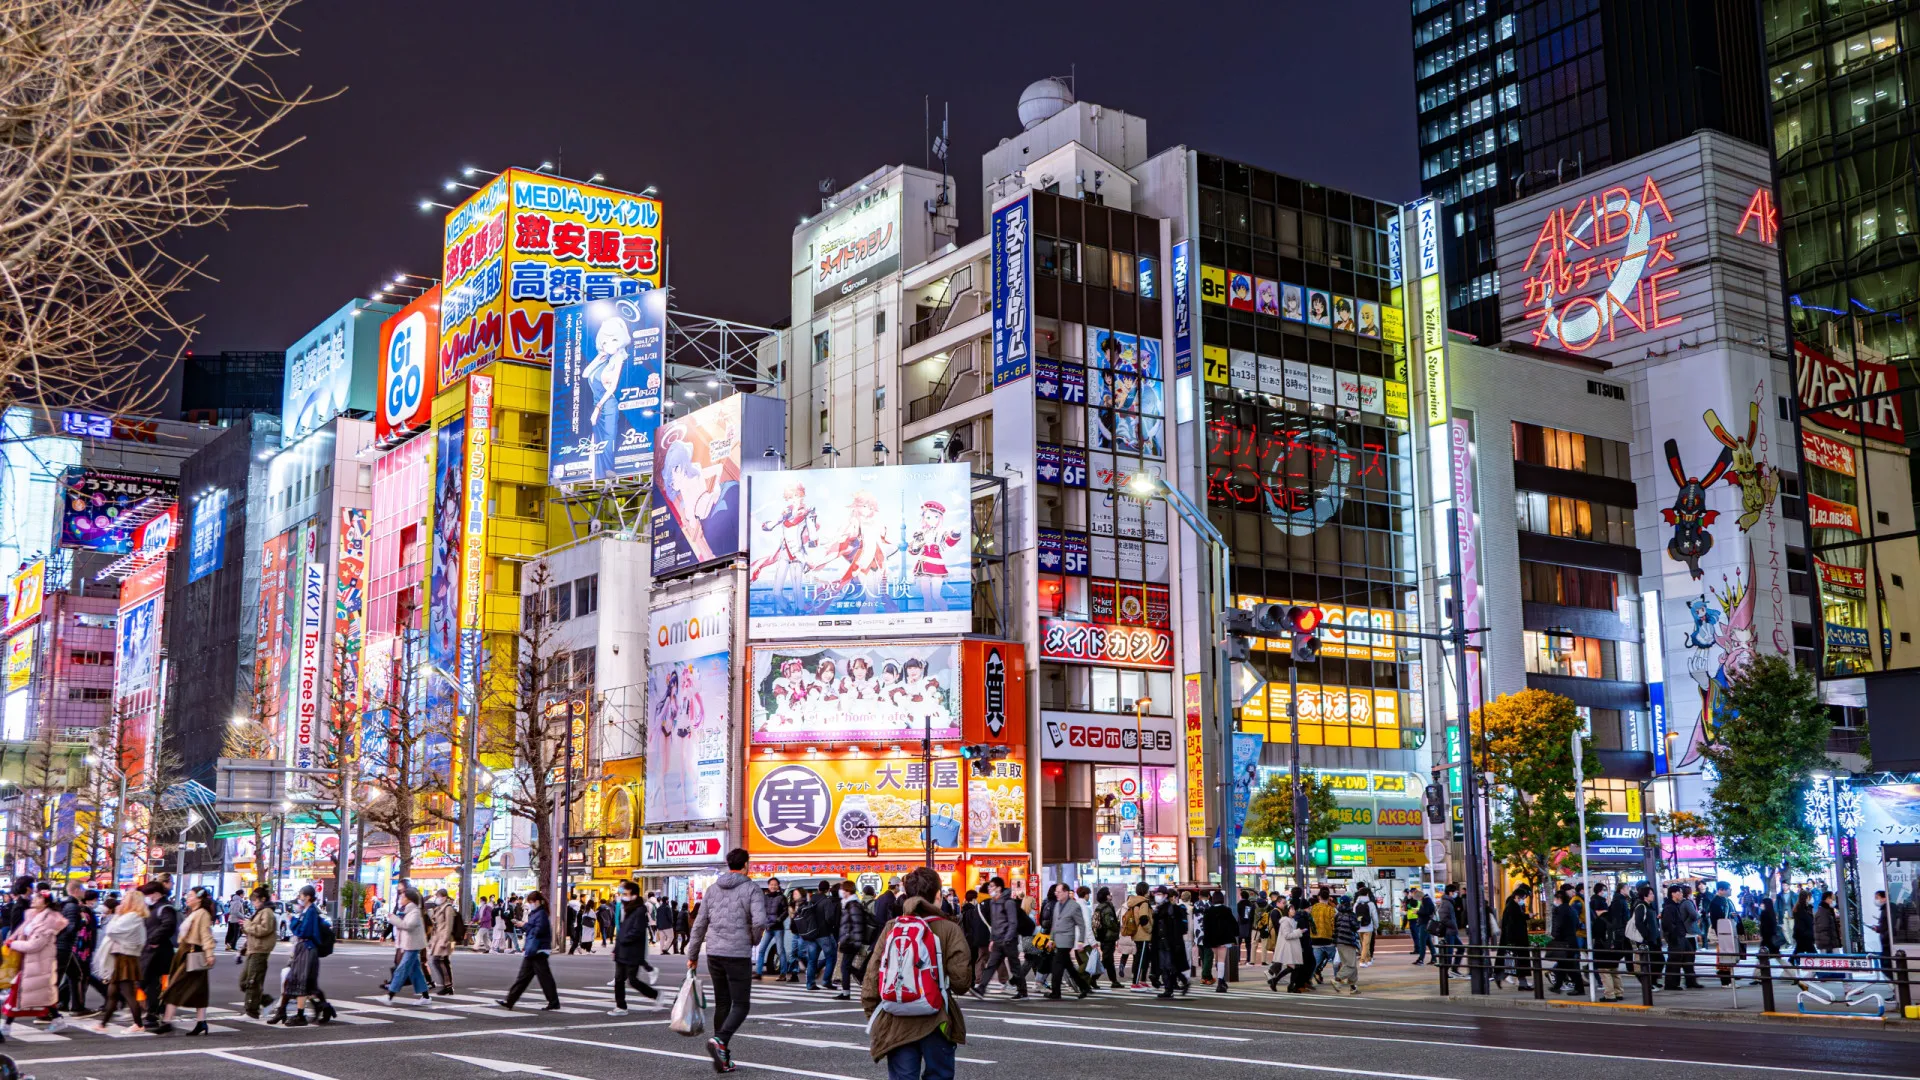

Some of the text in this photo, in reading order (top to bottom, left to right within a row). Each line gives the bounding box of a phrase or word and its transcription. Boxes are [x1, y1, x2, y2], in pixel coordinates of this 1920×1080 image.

[1522, 175, 1672, 272] AKIBA
[445, 213, 505, 286] 激安販売
[515, 214, 657, 276] 激安販売
[820, 222, 893, 282] メイドカジノ
[1006, 205, 1027, 362] アメニティードリーム
[1523, 231, 1679, 307] カルチャーズ
[1202, 280, 1226, 302] 8F
[1524, 268, 1683, 351] ZONE
[441, 311, 502, 380] Mulan
[1424, 307, 1439, 417] Yellow Submarine
[1204, 362, 1228, 383] 7F
[1063, 383, 1084, 402] 7F
[1386, 389, 1408, 400] GAME
[1587, 381, 1625, 401] MITSUWA
[1064, 466, 1086, 485] 6F
[468, 481, 483, 535] AKIBA
[1065, 553, 1087, 571] 5F
[307, 566, 320, 617] AKKY
[1092, 596, 1113, 607] Poker
[1092, 604, 1113, 617] Stars
[657, 612, 720, 648] amiami
[1045, 626, 1170, 660] メイドカジノ
[303, 635, 319, 703] Tax-free
[300, 703, 315, 745] Shop
[1297, 690, 1370, 724] あみあみ
[1070, 725, 1172, 750] スマホ修理王
[1653, 704, 1665, 757] GALLERIA
[837, 762, 954, 797] チケット 大黒屋
[1196, 769, 1204, 809] FREE
[1373, 775, 1406, 792] アニメ
[763, 778, 821, 840] 質
[1377, 809, 1423, 827] AKB48
[646, 838, 666, 862] ZIN
[666, 842, 693, 857] COMIC
[695, 840, 708, 855] ZIN
